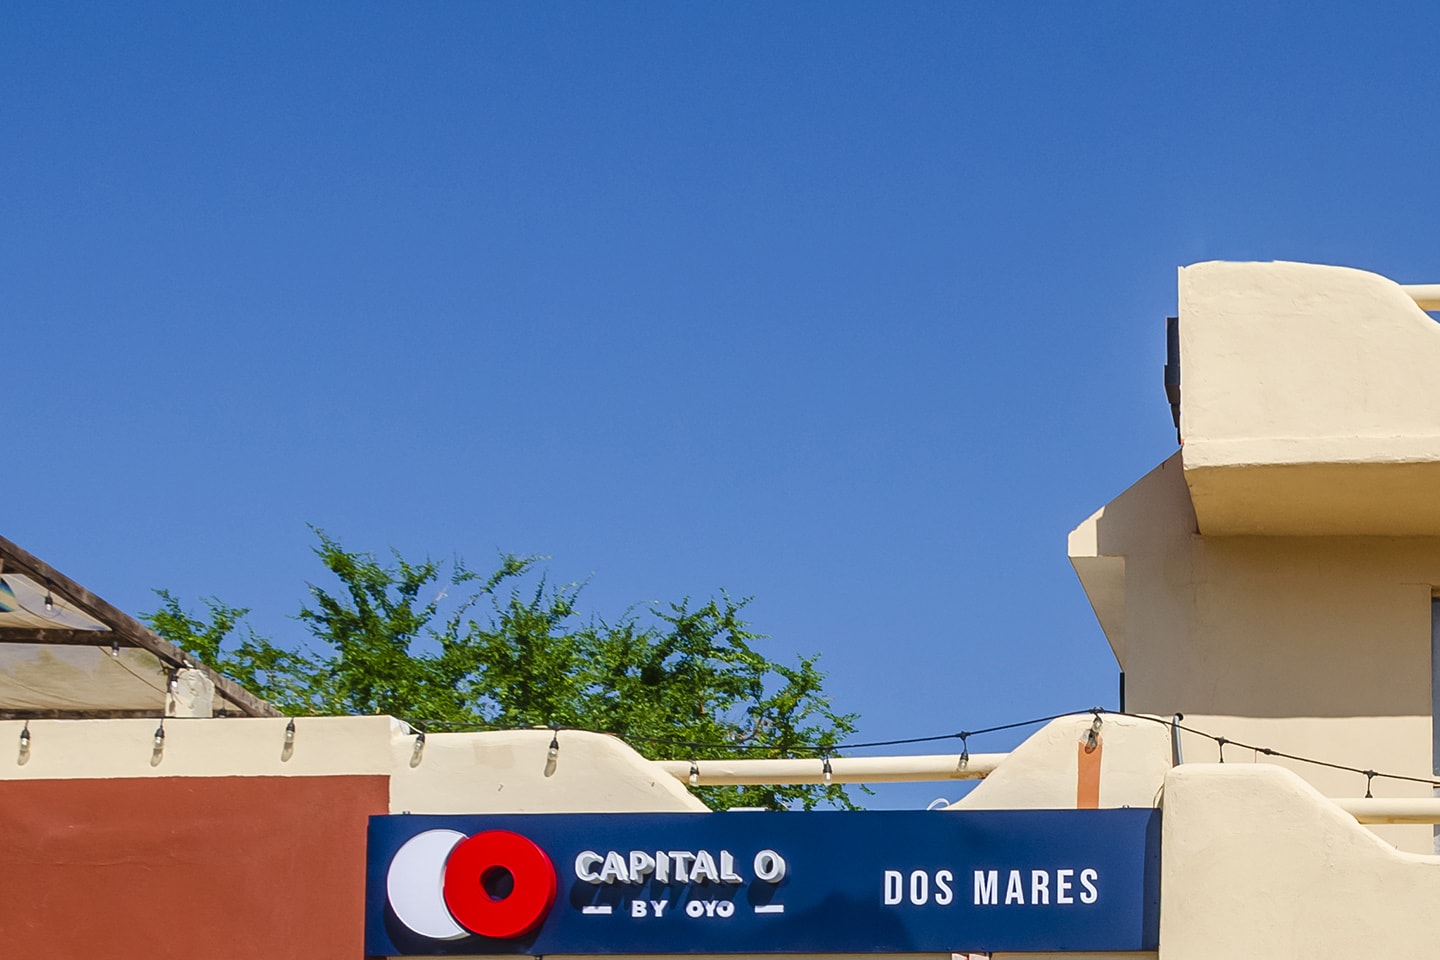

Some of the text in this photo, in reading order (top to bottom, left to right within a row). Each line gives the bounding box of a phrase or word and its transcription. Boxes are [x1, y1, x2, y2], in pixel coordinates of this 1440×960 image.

[574, 849, 786, 885] CAPITAL O
[884, 868, 1099, 906] DOS MARES
[631, 900, 736, 918] BY OYO
